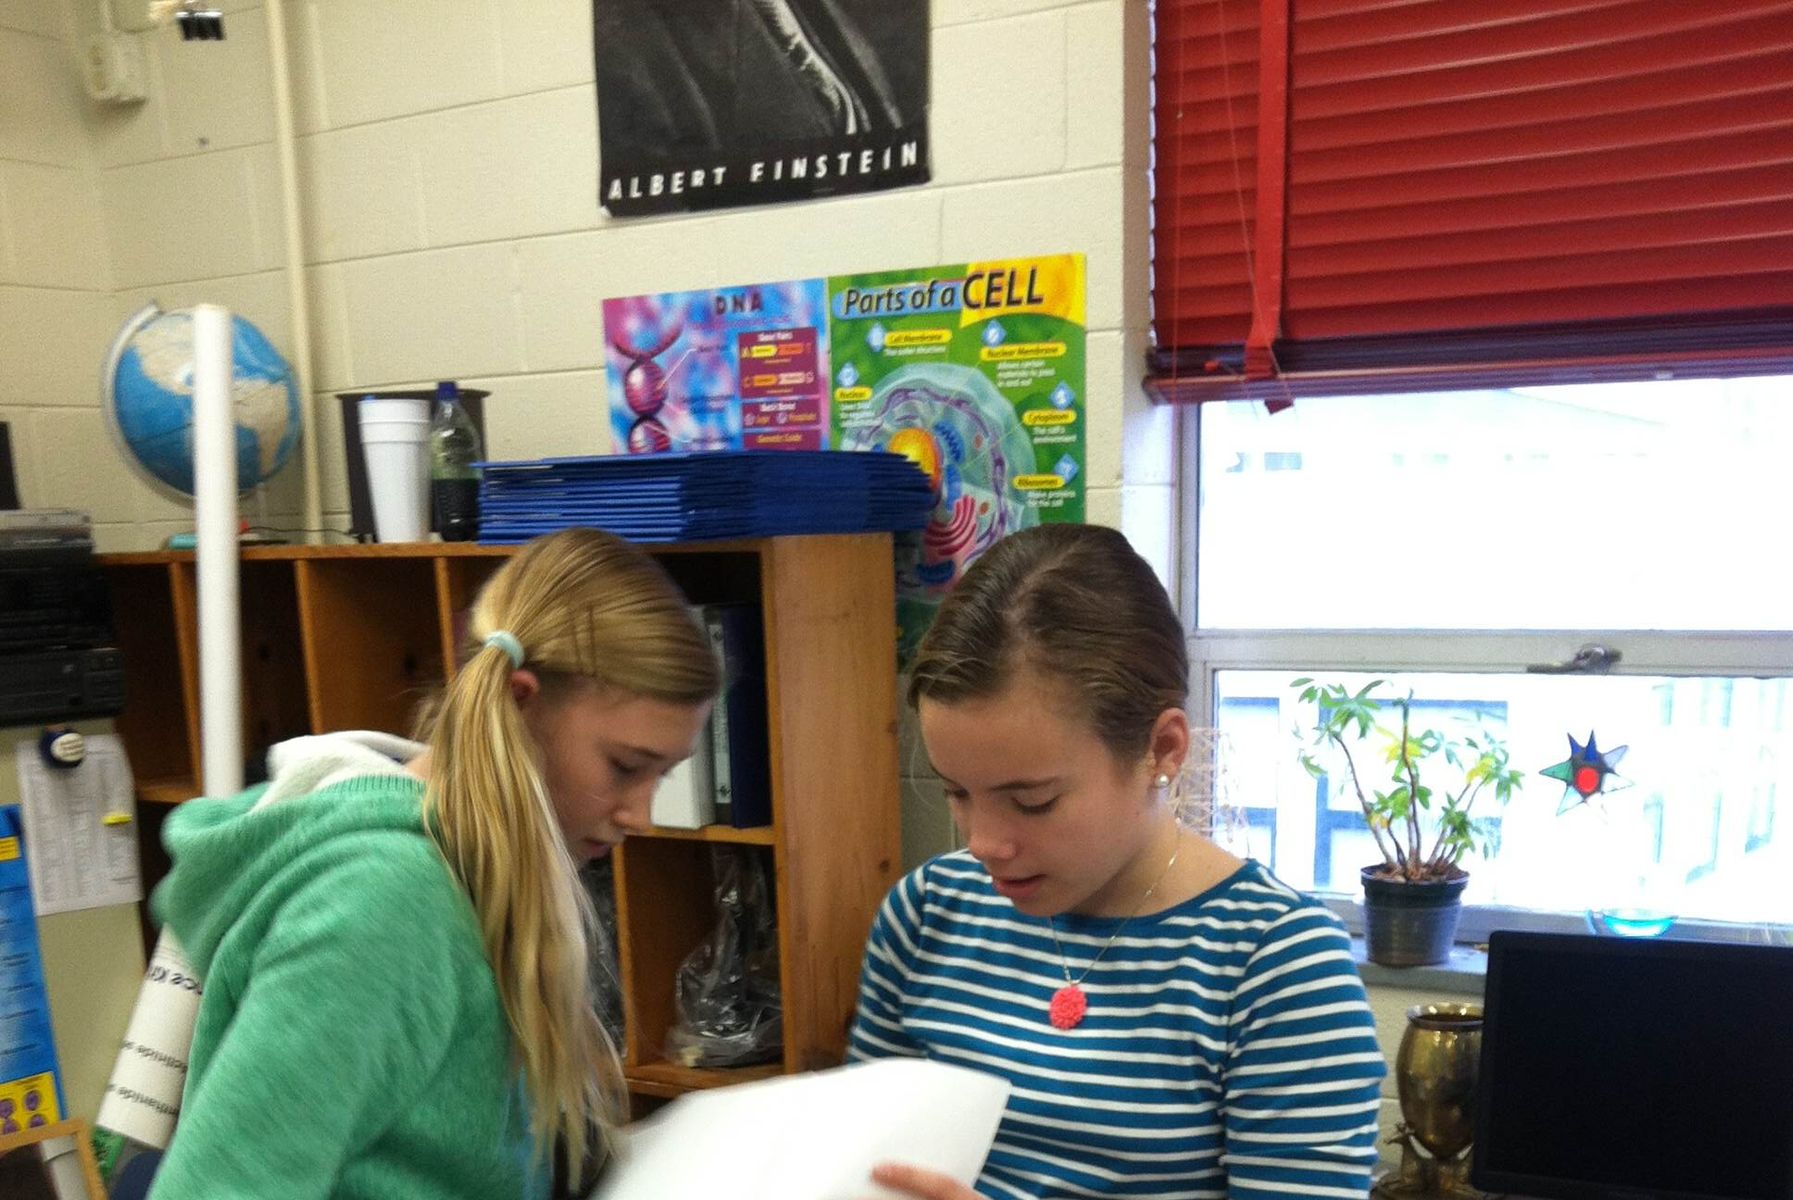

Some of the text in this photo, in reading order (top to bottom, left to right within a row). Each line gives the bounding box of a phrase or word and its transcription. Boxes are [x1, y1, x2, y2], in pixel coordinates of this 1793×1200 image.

[607, 141, 918, 200] ALBERT EINSTEIN
[715, 292, 763, 315] DNA
[844, 268, 1044, 315] Parts of a CELL
